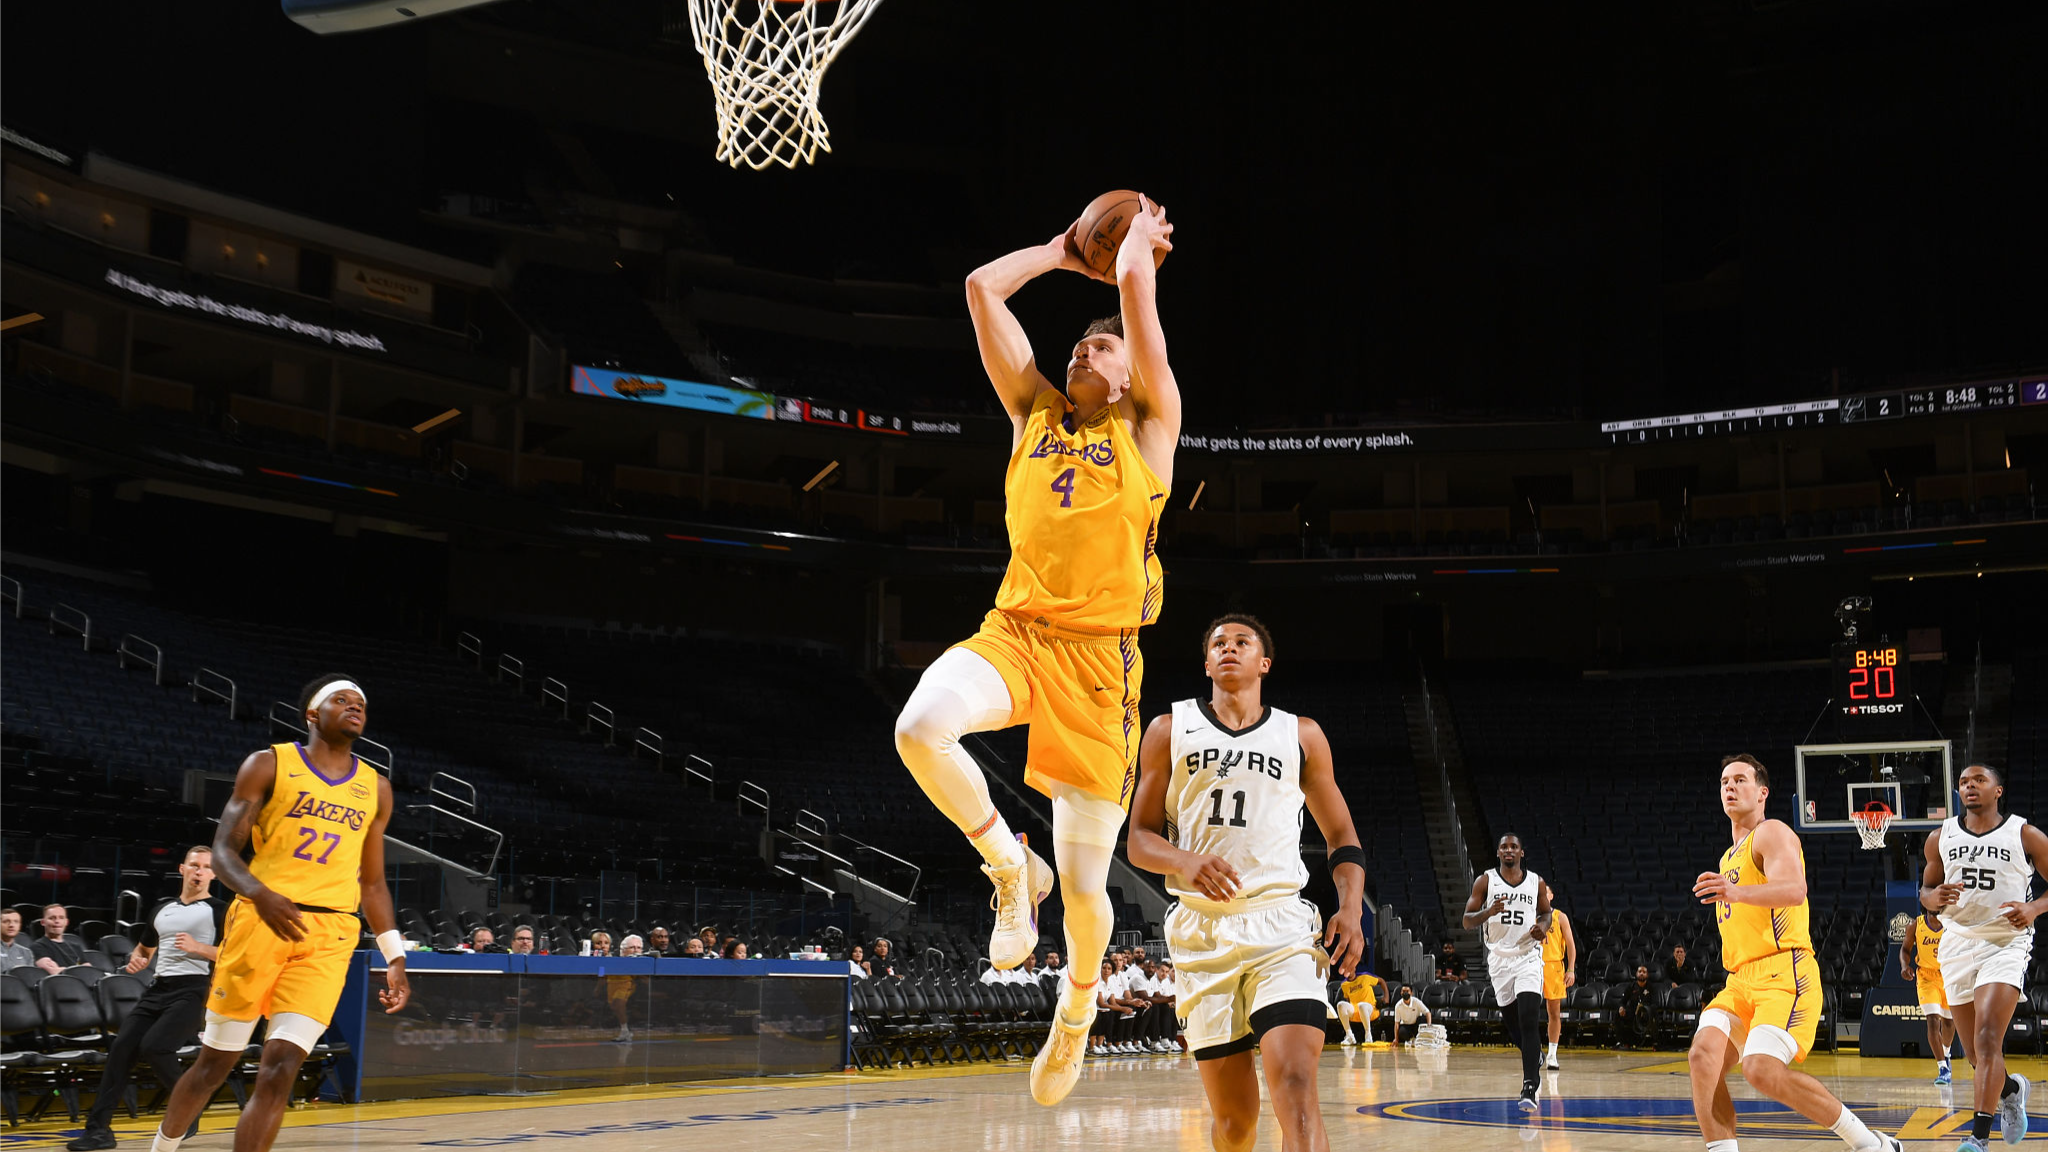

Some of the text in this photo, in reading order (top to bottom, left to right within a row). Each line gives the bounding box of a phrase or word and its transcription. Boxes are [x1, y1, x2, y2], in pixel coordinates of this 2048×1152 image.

[1928, 391, 1934, 401] 2
[1946, 387, 1976, 404] 8:48
[2008, 383, 2014, 393] 2
[2036, 383, 2047, 400] 2
[1879, 399, 1889, 416] 2
[1611, 433, 1617, 444] 1
[1639, 430, 1646, 441] 0
[1697, 425, 1704, 435] 0
[1787, 416, 1794, 426] 0
[1817, 412, 1824, 423] 2
[1180, 432, 1414, 452] that gets the stats of every splash.
[1051, 468, 1076, 508] 4
[1789, 553, 1825, 563] Warriors
[1384, 571, 1417, 581] Warriors
[1855, 649, 1897, 667] 8:48
[1849, 667, 1895, 699] 20
[1859, 704, 1904, 714] TISSOT
[1185, 748, 1283, 781] SPURS
[284, 791, 367, 831] LAKERS
[1207, 788, 1247, 828] 11
[293, 826, 341, 865] 27
[1961, 867, 1996, 891] 55
[1500, 910, 1525, 926] 25
